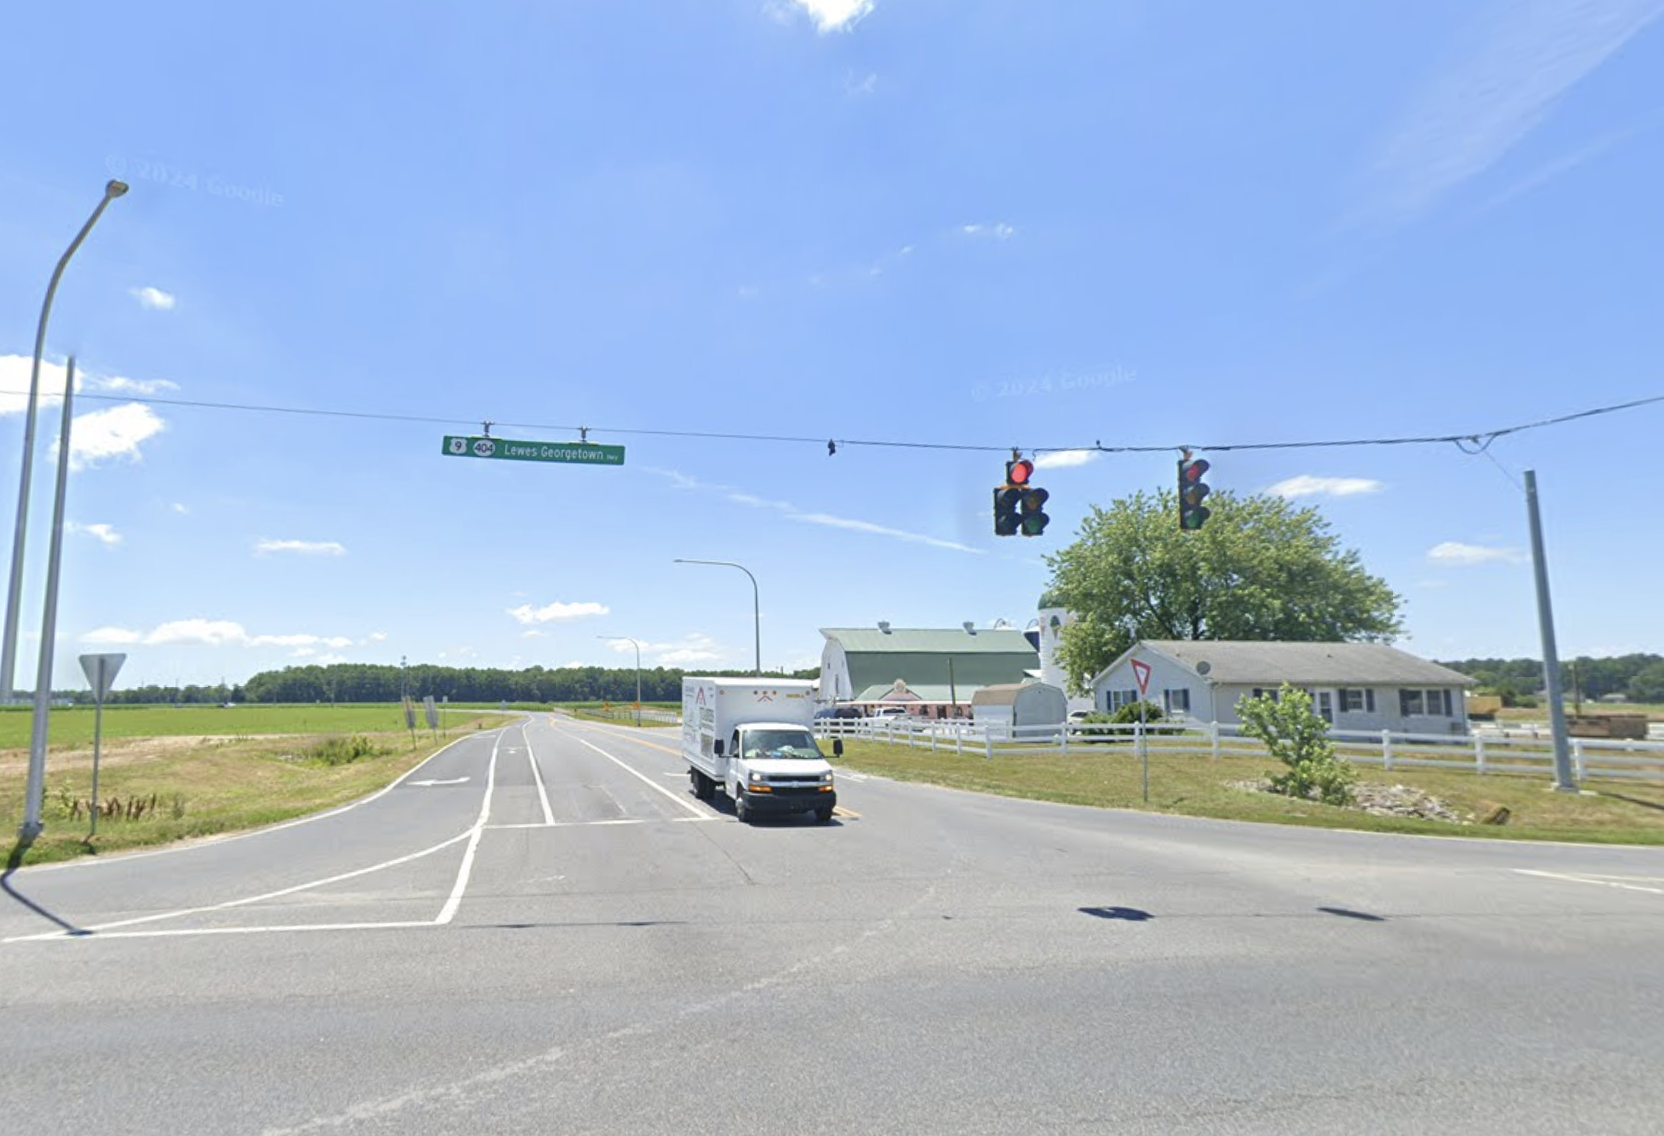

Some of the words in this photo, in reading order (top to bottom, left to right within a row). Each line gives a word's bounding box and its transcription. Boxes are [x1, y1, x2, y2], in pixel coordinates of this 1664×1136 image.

[454, 441, 462, 451] 9
[473, 442, 493, 454] 404
[504, 444, 537, 457] Lewes
[541, 445, 604, 461] Georgetown
